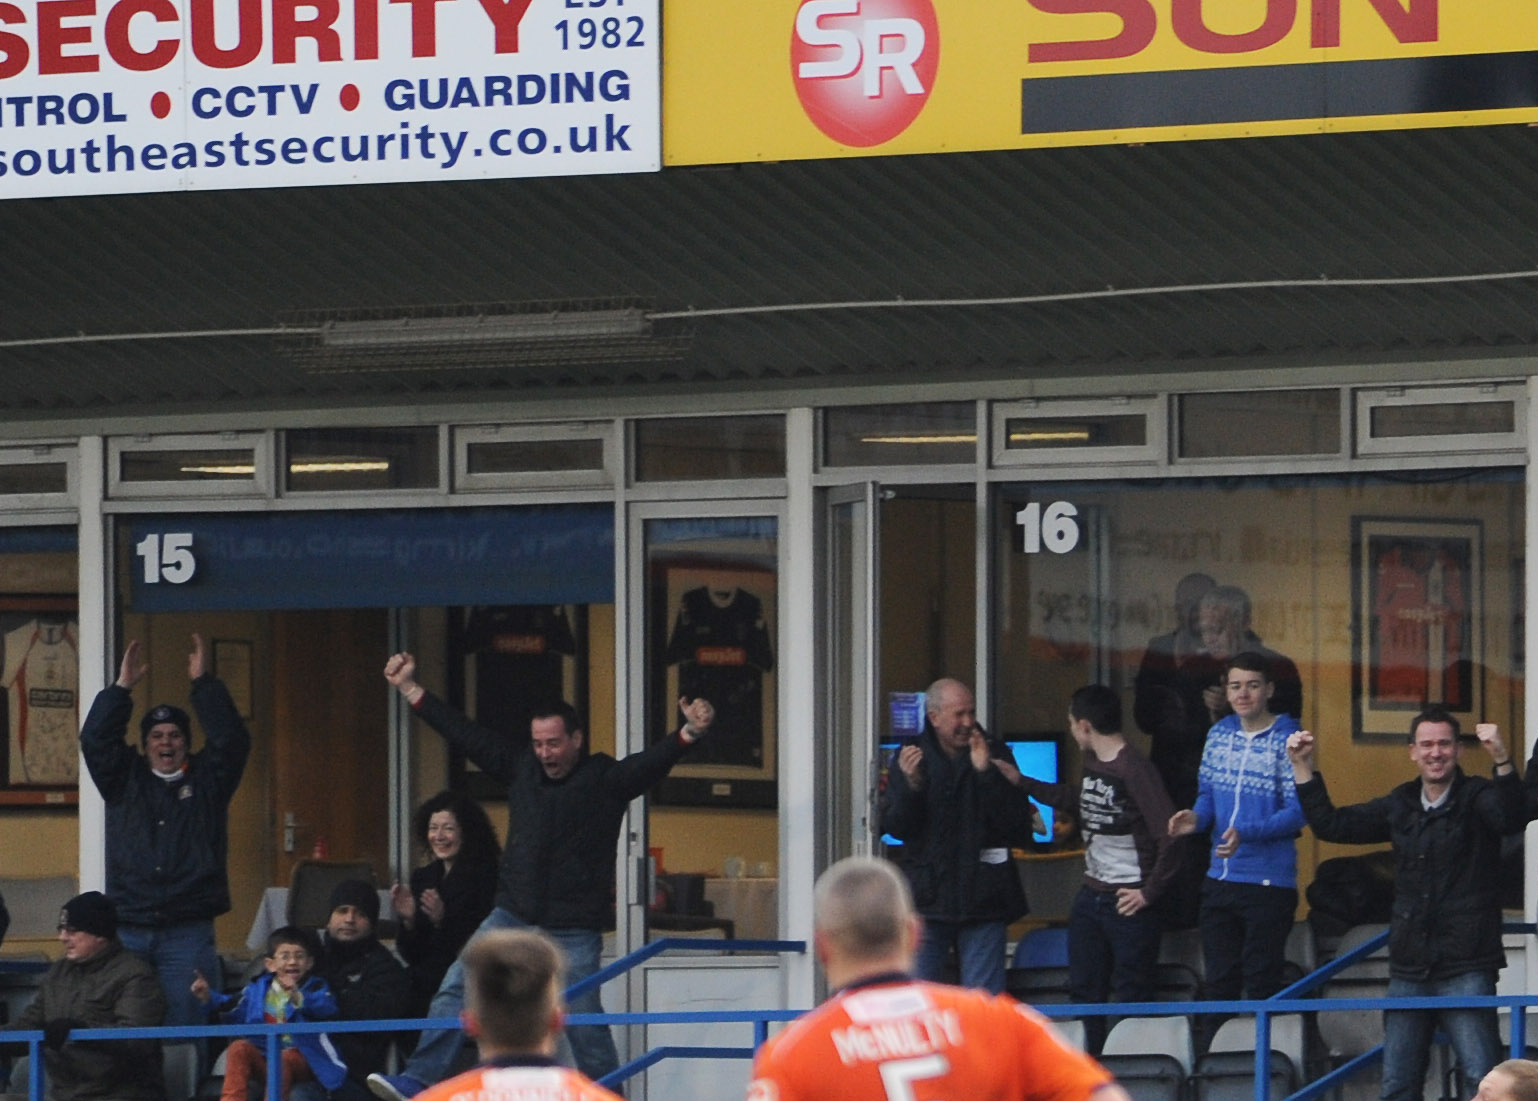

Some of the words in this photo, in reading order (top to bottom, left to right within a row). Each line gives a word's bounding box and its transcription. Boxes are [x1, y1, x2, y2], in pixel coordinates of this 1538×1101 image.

[555, 16, 645, 50] 1982
[0, 92, 127, 127] TROL
[191, 83, 319, 119] CCTV
[384, 69, 631, 111] GUARDING
[1016, 501, 1080, 554] 16
[136, 532, 196, 584] 15
